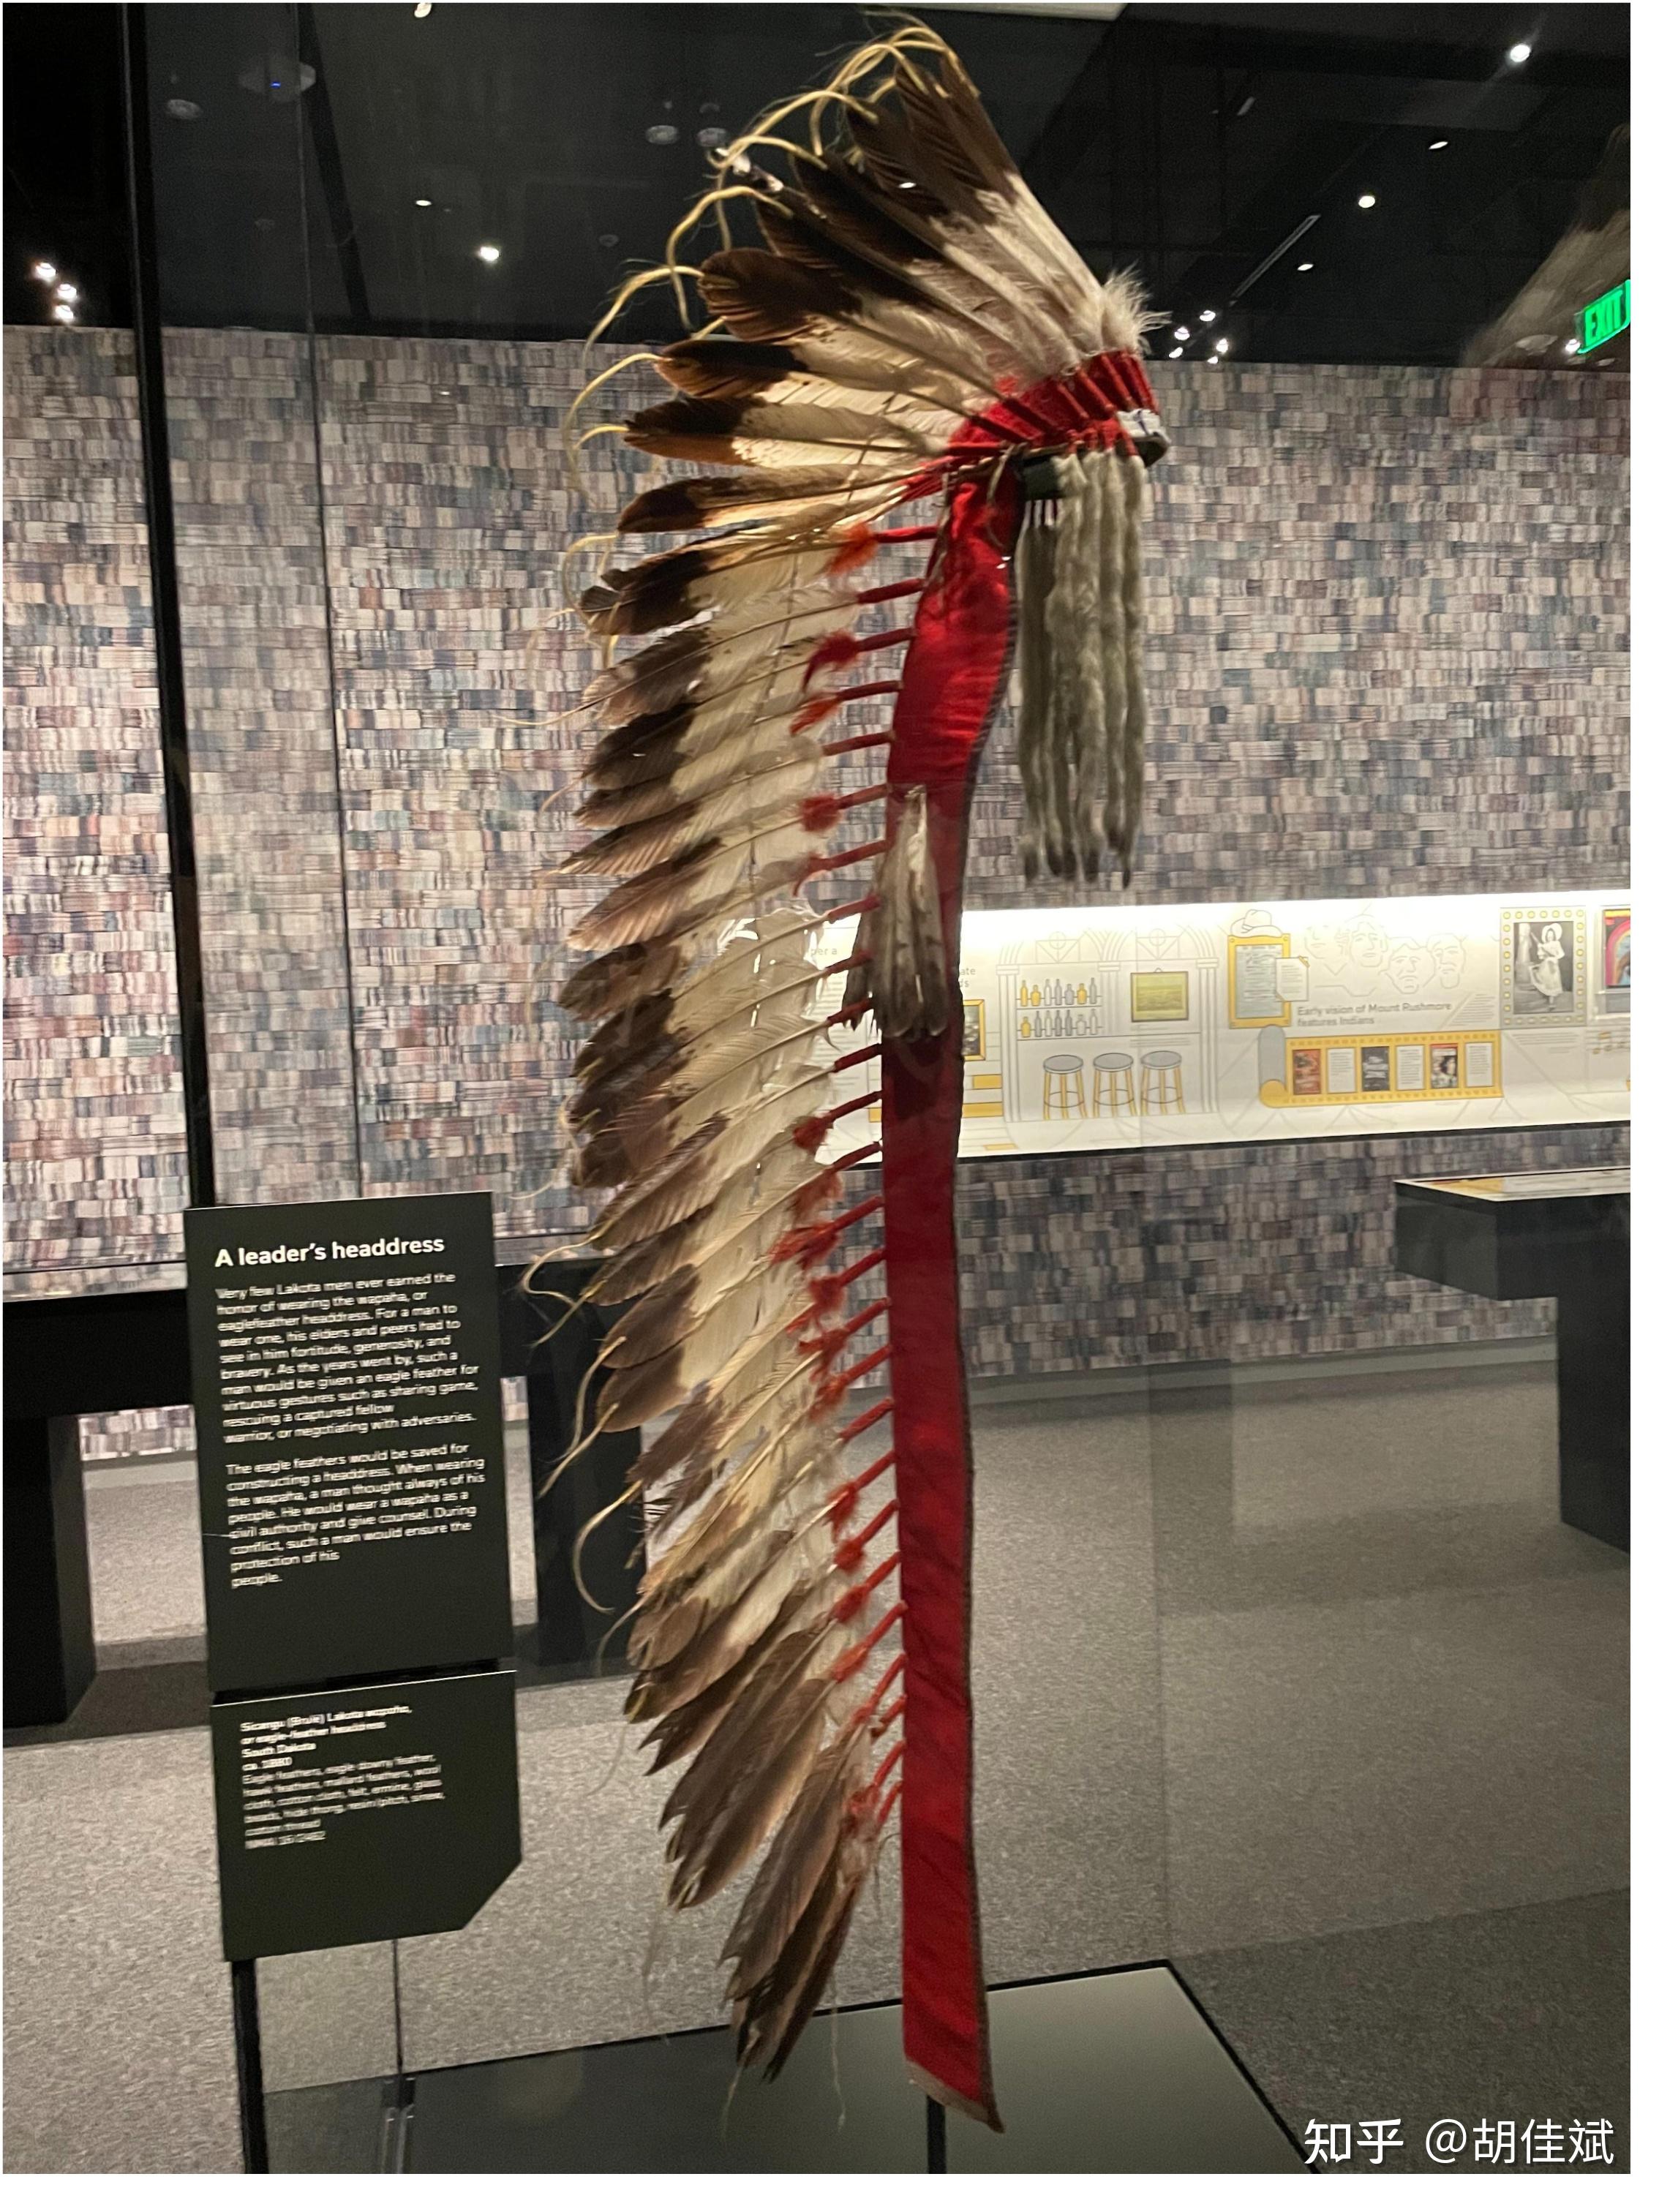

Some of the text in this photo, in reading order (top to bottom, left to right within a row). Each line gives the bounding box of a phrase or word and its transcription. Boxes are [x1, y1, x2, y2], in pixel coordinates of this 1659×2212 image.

[1585, 289, 1624, 347] EXIT
[1298, 1002, 1452, 1017] Early vision of Mount Rushmore
[1339, 1016, 1374, 1026] Indians
[214, 1237, 445, 1267] A leader’s headdress
[276, 1283, 321, 1295] Lakota
[323, 1282, 353, 1291] men
[355, 1279, 384, 1289] ever
[385, 1273, 432, 1287] earned
[433, 1273, 456, 1283] the
[216, 1304, 258, 1314] honor
[259, 1301, 276, 1312] of
[331, 1295, 355, 1306] the
[412, 1292, 428, 1301] or
[301, 1312, 374, 1324] headdress.
[375, 1307, 397, 1318] For
[400, 1309, 409, 1317] a
[411, 1306, 440, 1316] man
[442, 1304, 457, 1314] to
[218, 1337, 252, 1347] wear
[286, 1331, 307, 1342] his
[309, 1328, 350, 1340] elders
[351, 1325, 377, 1336] and
[379, 1323, 417, 1336] peers
[418, 1320, 444, 1331] had
[445, 1320, 461, 1329] to
[219, 1353, 245, 1363] see
[246, 1350, 261, 1361] in
[262, 1348, 289, 1359] him
[426, 1334, 451, 1347] and
[276, 1363, 296, 1374] As
[296, 1362, 320, 1373] the
[321, 1360, 358, 1373] years
[358, 1356, 393, 1367] went
[415, 1350, 448, 1363] such
[449, 1352, 458, 1360] a
[221, 1385, 252, 1395] man
[253, 1379, 295, 1392] would
[296, 1378, 315, 1389] be
[356, 1374, 373, 1384] an
[375, 1370, 410, 1383] eagle
[412, 1366, 457, 1378] feather
[460, 1364, 479, 1374] for
[278, 1393, 336, 1409] gestures
[337, 1388, 370, 1402] such
[371, 1389, 388, 1399] as
[388, 1383, 437, 1396] sharing
[222, 1404, 394, 1427] rescuing a captured fellow
[276, 1429, 293, 1438] or
[293, 1421, 369, 1438] negotiating
[370, 1418, 399, 1429] with
[225, 1442, 470, 1475] The eagle feathers would be saved for
[226, 1474, 310, 1491] constructing
[312, 1474, 322, 1483] a
[323, 1467, 394, 1481] headdress.
[395, 1463, 433, 1474] When
[226, 1496, 250, 1507] the
[308, 1490, 319, 1499] a
[320, 1487, 350, 1497] man
[351, 1481, 403, 1494] thought
[404, 1478, 448, 1489] always
[449, 1473, 464, 1485] of
[466, 1472, 486, 1483] his
[227, 1509, 280, 1525] people.
[280, 1506, 301, 1517] He
[302, 1501, 343, 1515] would
[345, 1500, 378, 1511] wear
[380, 1499, 389, 1508] a
[442, 1492, 458, 1501] as
[459, 1491, 469, 1500] a
[228, 1526, 257, 1539] civil
[319, 1517, 346, 1530] and
[347, 1515, 376, 1529] give
[433, 1505, 477, 1518] During
[285, 1536, 318, 1549] such
[320, 1537, 330, 1546] a
[331, 1533, 361, 1544] man
[361, 1527, 402, 1540] would
[404, 1524, 448, 1536] ensure
[449, 1521, 472, 1532] the
[230, 1549, 340, 1573] protection of his
[231, 1573, 282, 1589] people.
